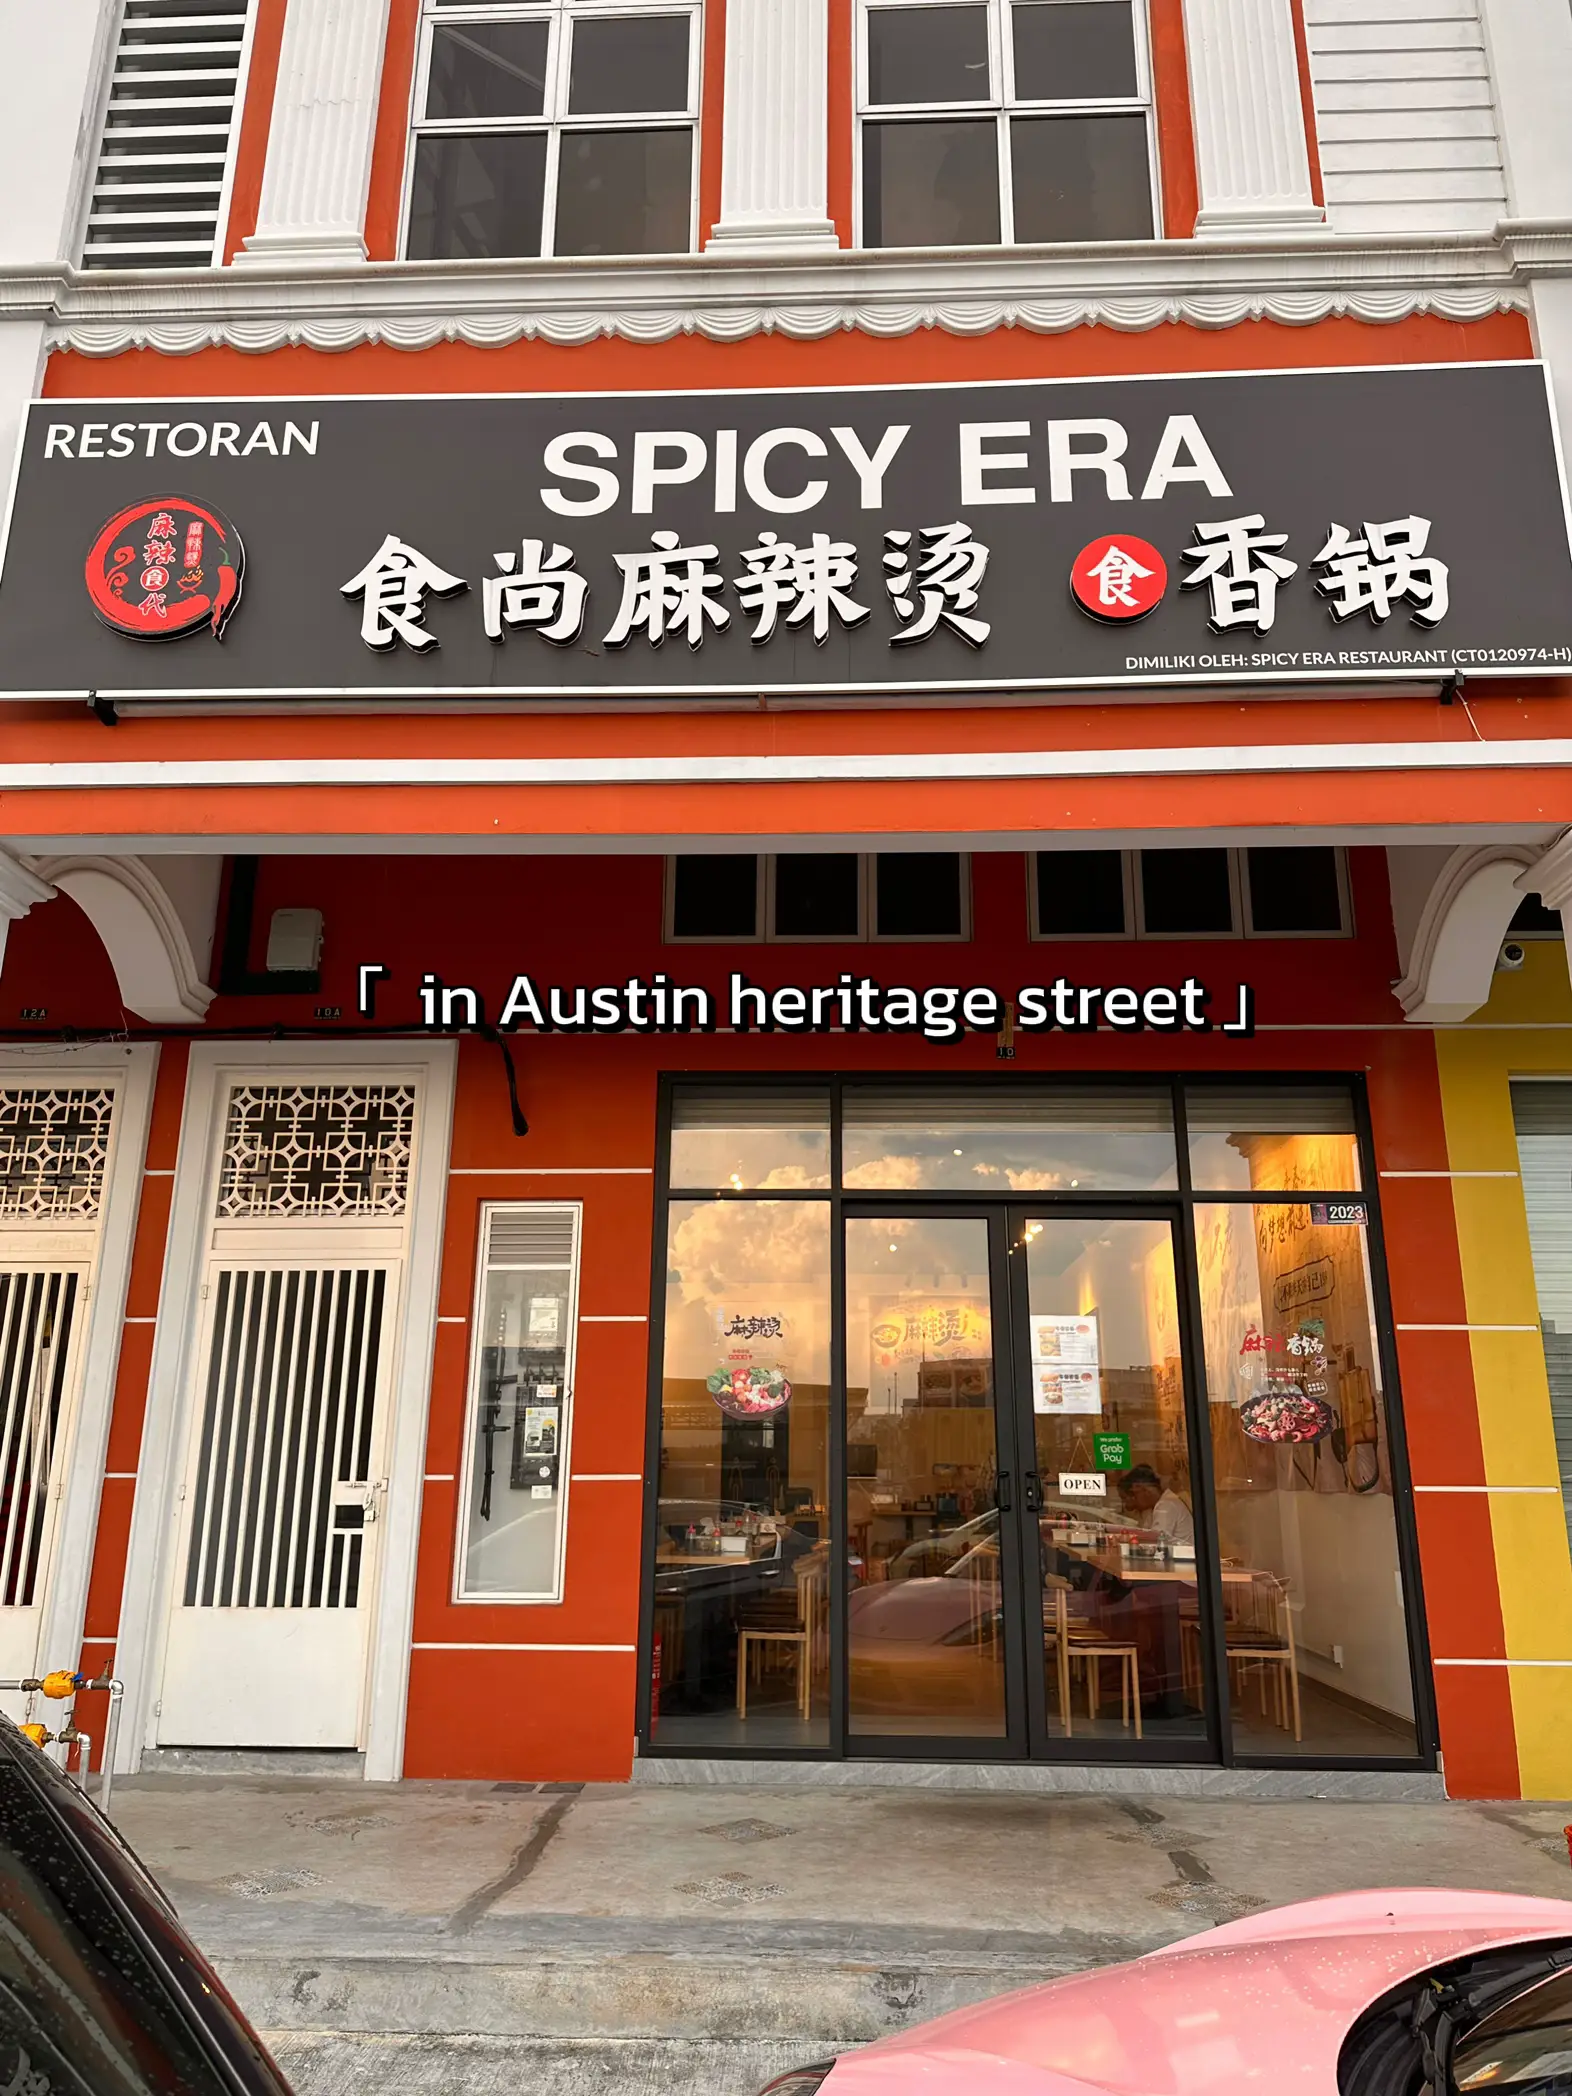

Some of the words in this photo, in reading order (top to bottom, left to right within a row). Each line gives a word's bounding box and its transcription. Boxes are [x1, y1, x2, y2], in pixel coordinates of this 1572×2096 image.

[44, 421, 320, 460] RESTORAN
[540, 424, 912, 518] SPICY
[959, 414, 1234, 506] ERA
[340, 520, 992, 655] 食尚麻辣烫
[1125, 655, 1196, 670] DIMILIKI
[1198, 654, 1249, 668] OLEH:
[1251, 652, 1300, 667] SPICY
[1302, 651, 1337, 665] ERA
[1338, 650, 1448, 665] RESTAURANT
[1450, 647, 1572, 664] (CT0120974-H)
[23, 1008, 46, 1017] 12A
[317, 1008, 340, 1016] 10A
[1329, 1205, 1364, 1219] 2023
[724, 1314, 783, 1340] 麻辣烫
[1100, 1443, 1124, 1454] Grab
[1103, 1453, 1123, 1465] Pay
[1063, 1478, 1102, 1491] OPEN
